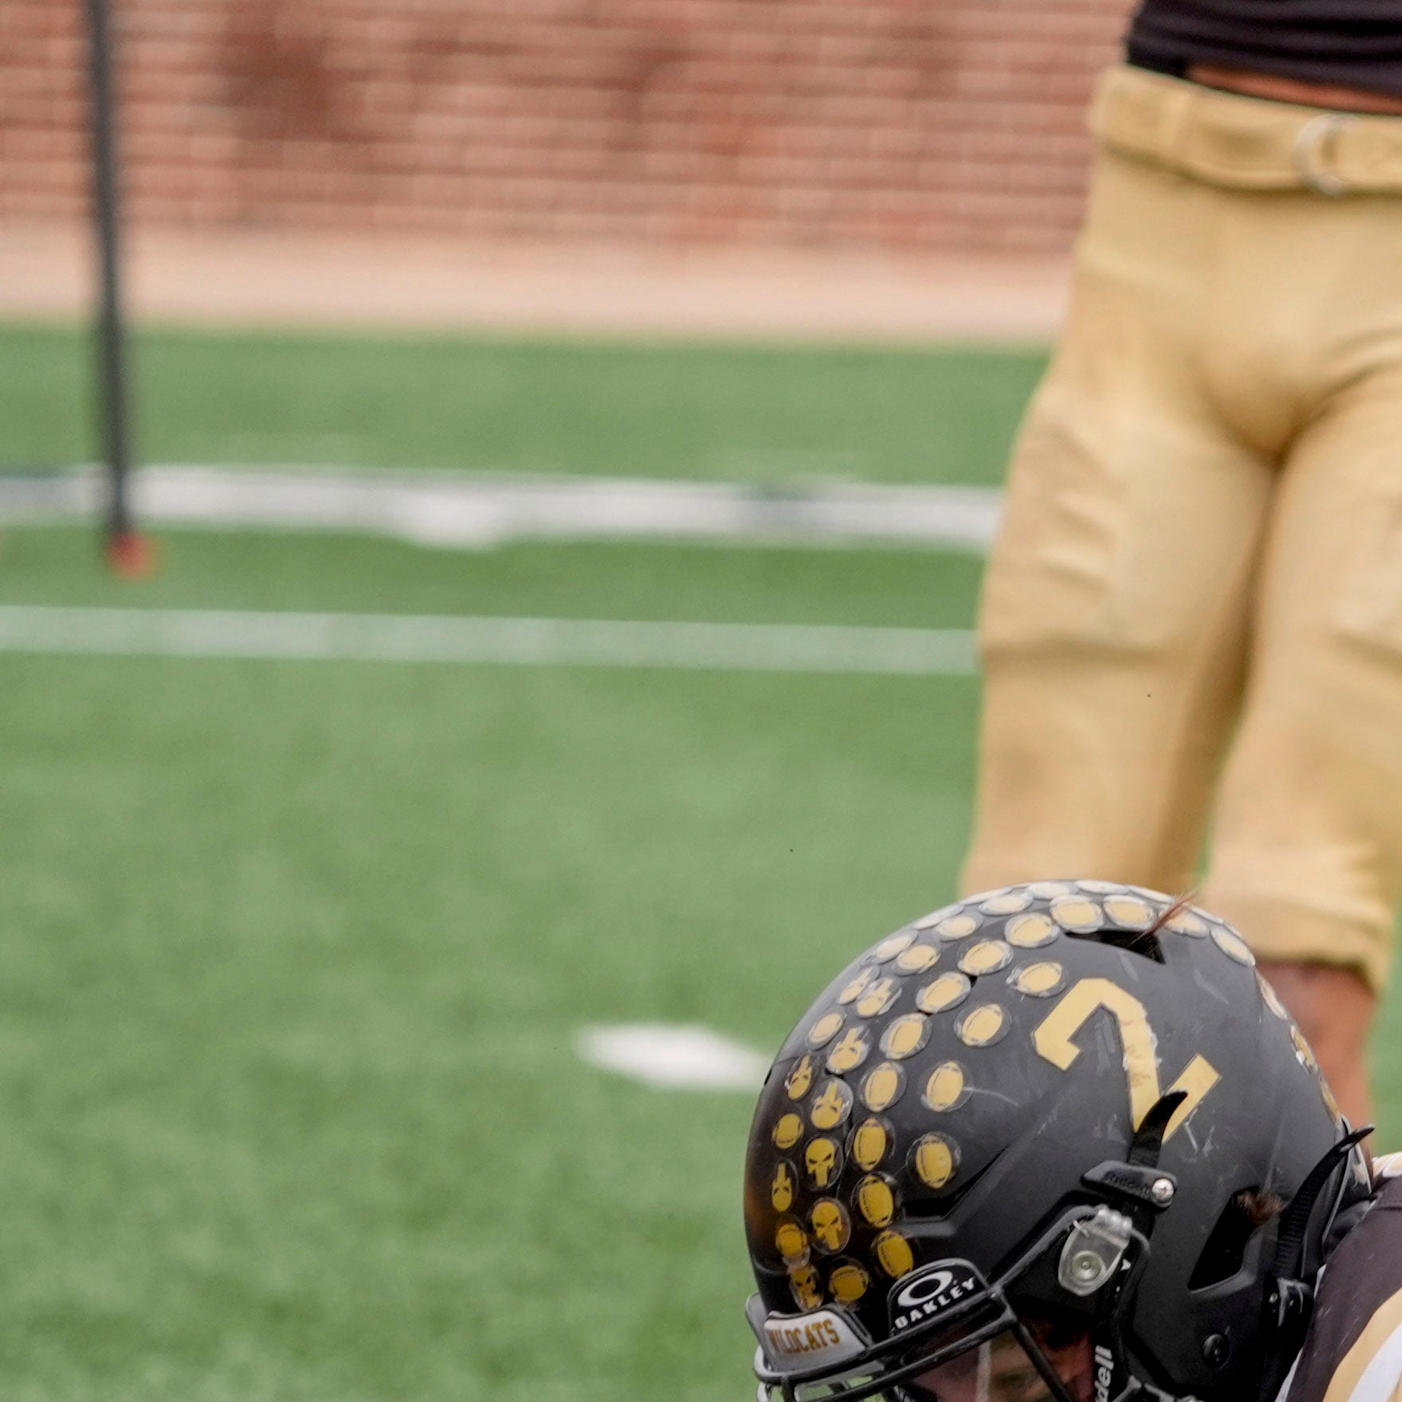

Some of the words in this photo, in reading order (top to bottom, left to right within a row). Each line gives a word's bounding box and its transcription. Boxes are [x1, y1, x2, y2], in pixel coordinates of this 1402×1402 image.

[1032, 977, 1221, 1144] 2
[894, 1277, 974, 1329] OAKLEY
[767, 1319, 840, 1353] WILDCATS
